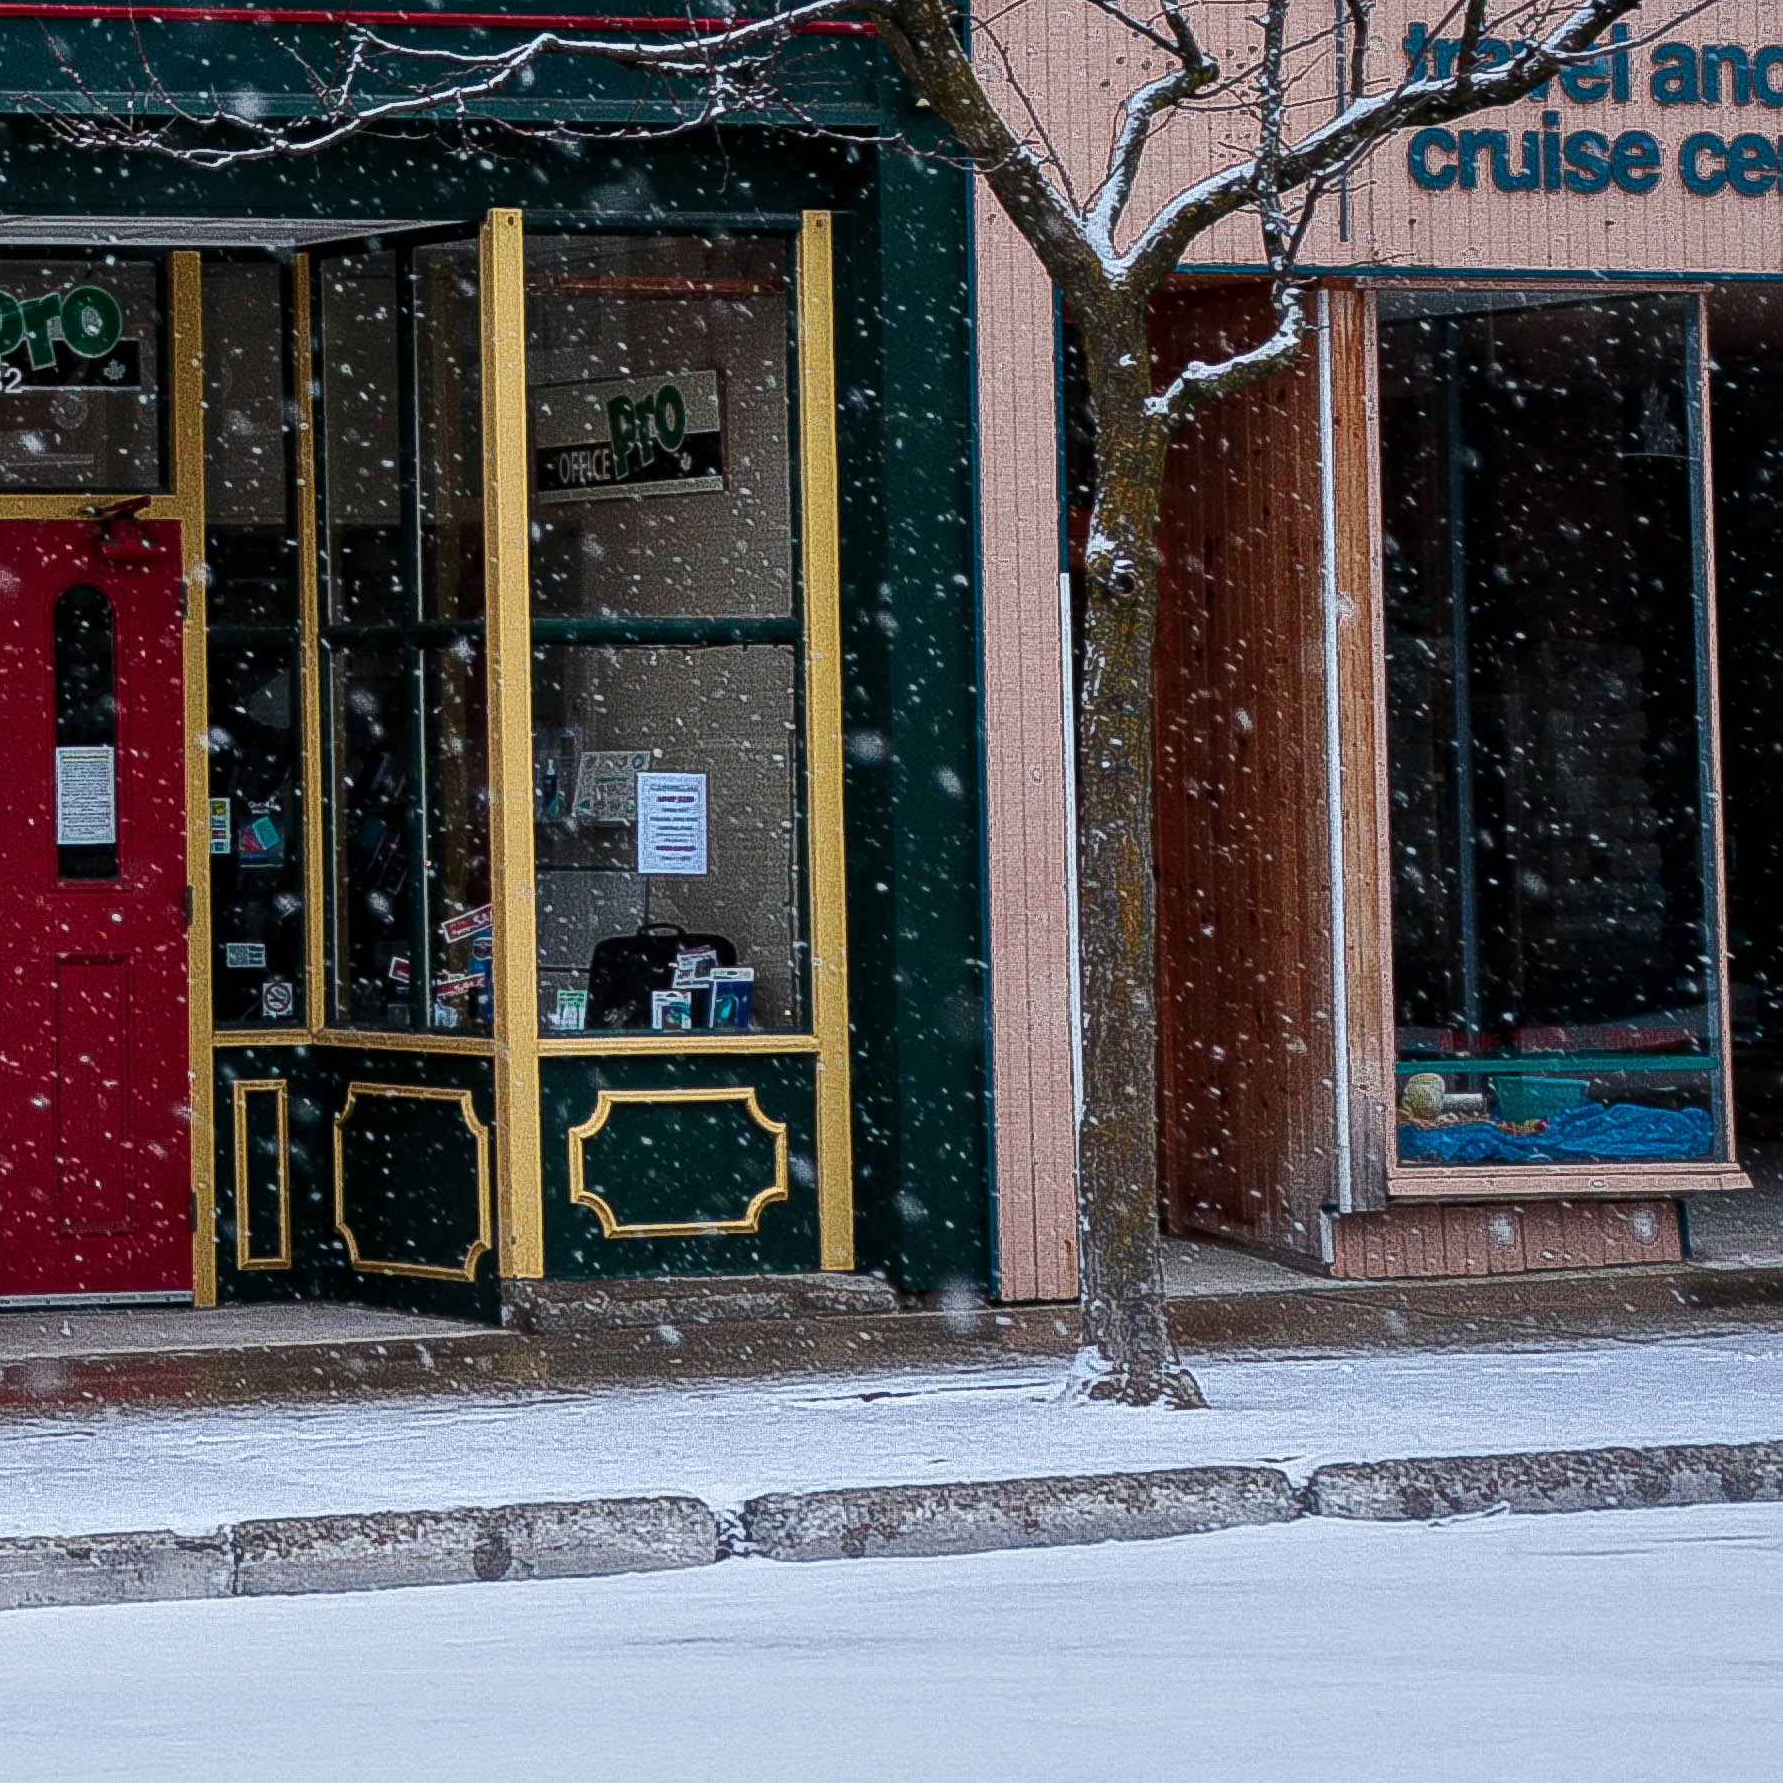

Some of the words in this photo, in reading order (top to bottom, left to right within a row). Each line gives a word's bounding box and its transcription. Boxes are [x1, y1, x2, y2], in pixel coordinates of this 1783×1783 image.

[1407, 110, 1663, 195] cruise
[1678, 129, 1783, 197] ce
[558, 447, 612, 485] OFFICE
